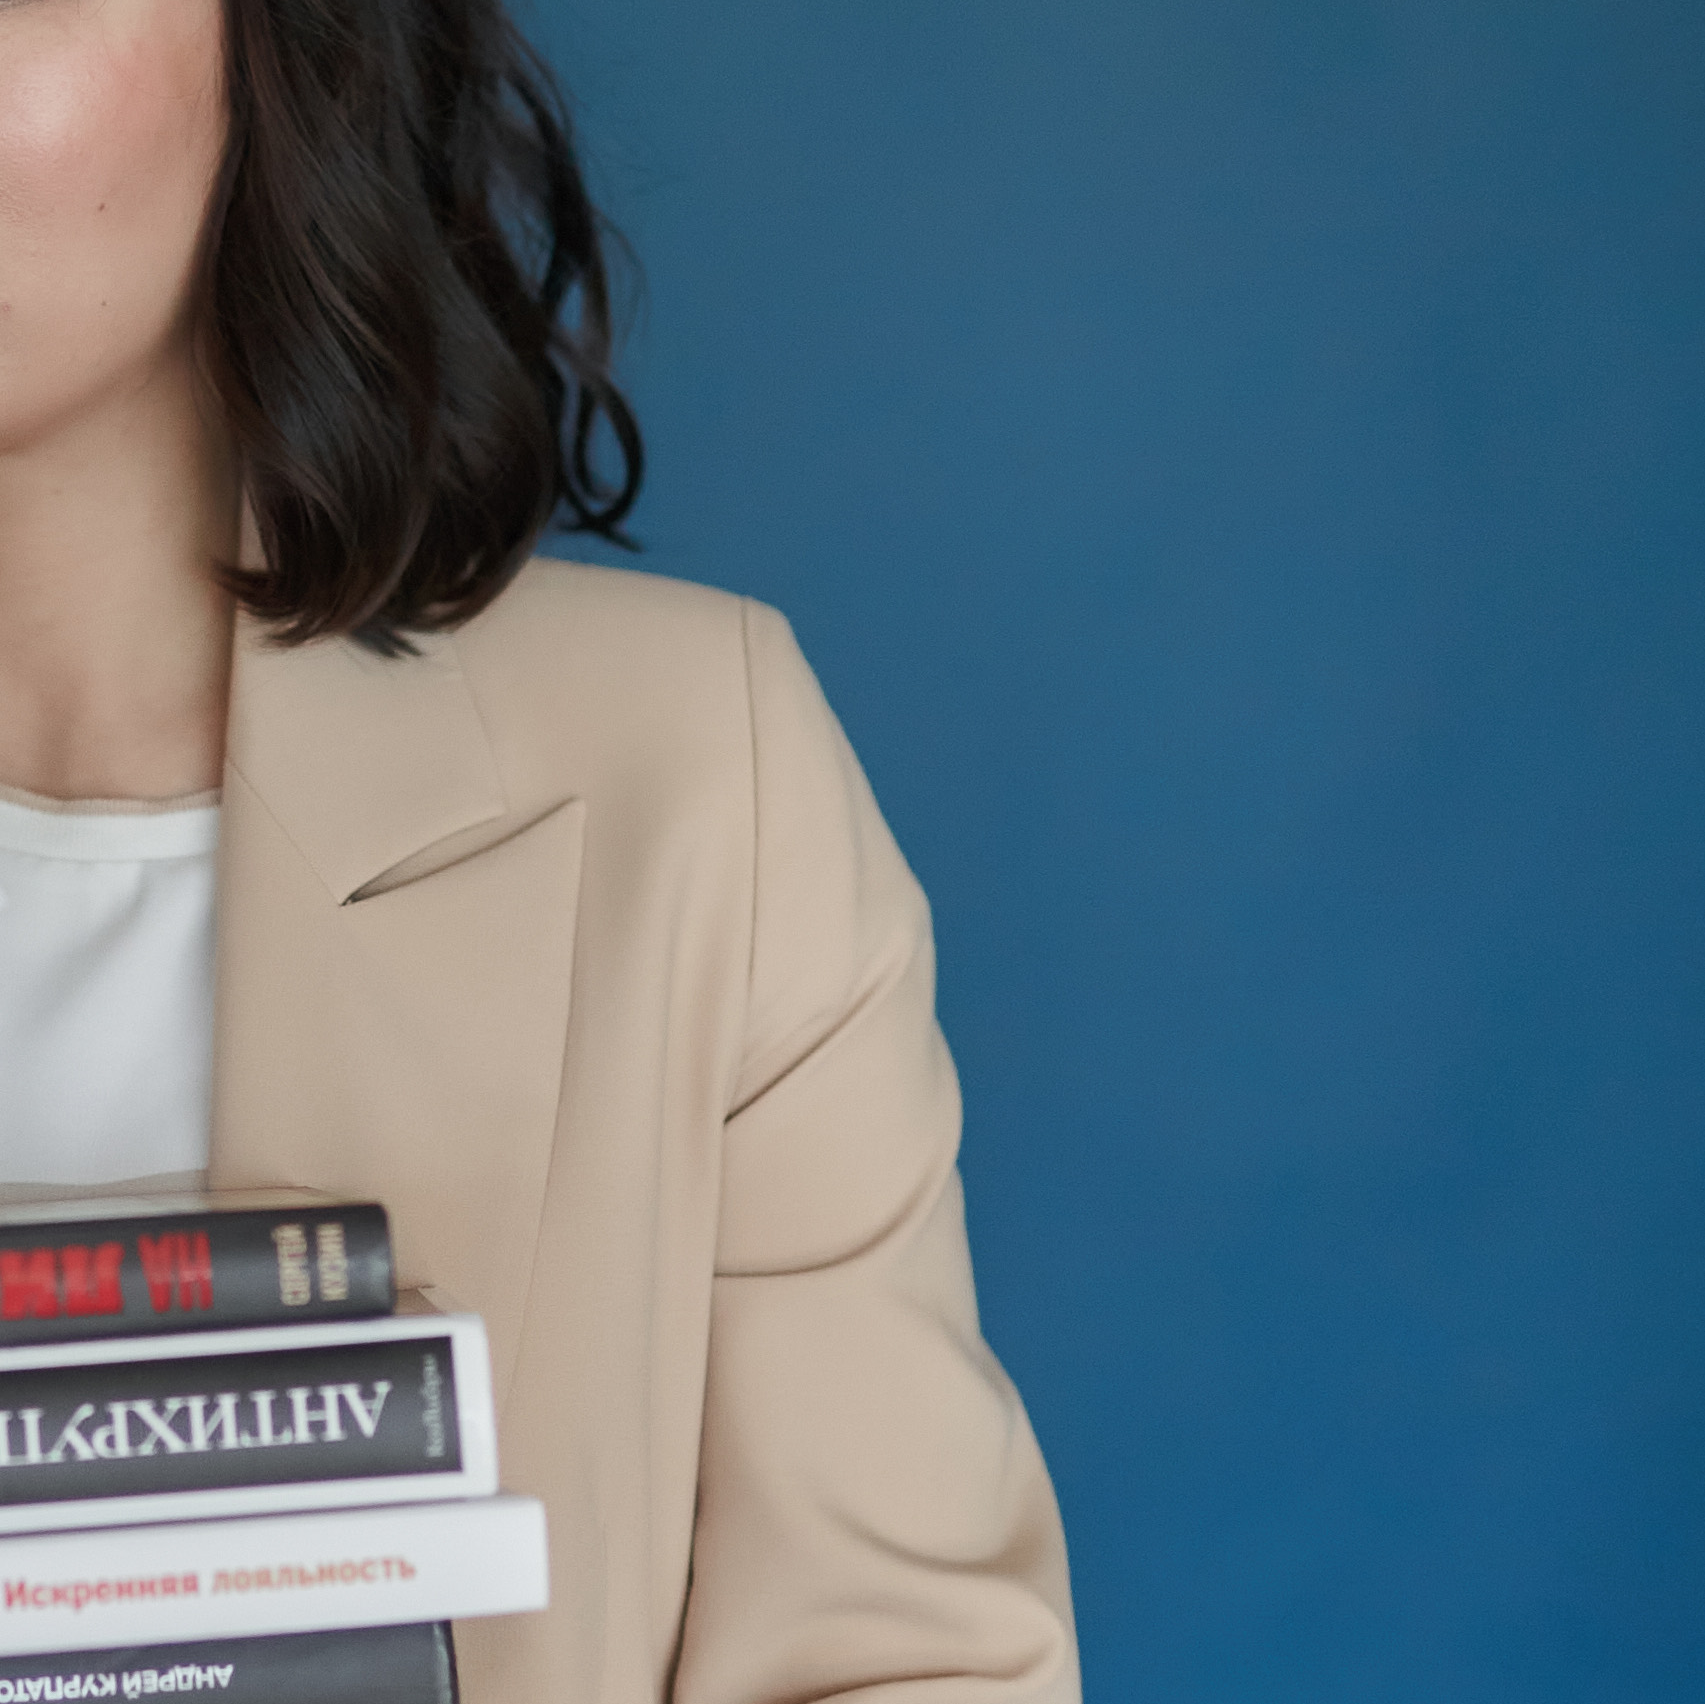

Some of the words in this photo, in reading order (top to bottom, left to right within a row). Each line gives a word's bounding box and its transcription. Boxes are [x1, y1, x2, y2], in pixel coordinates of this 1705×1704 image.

[138, 1231, 213, 1312] НА
[3, 1569, 198, 1612] Искренняя
[212, 1554, 416, 1593] лояльность
[124, 1663, 233, 1698] АНДРЕЙ
